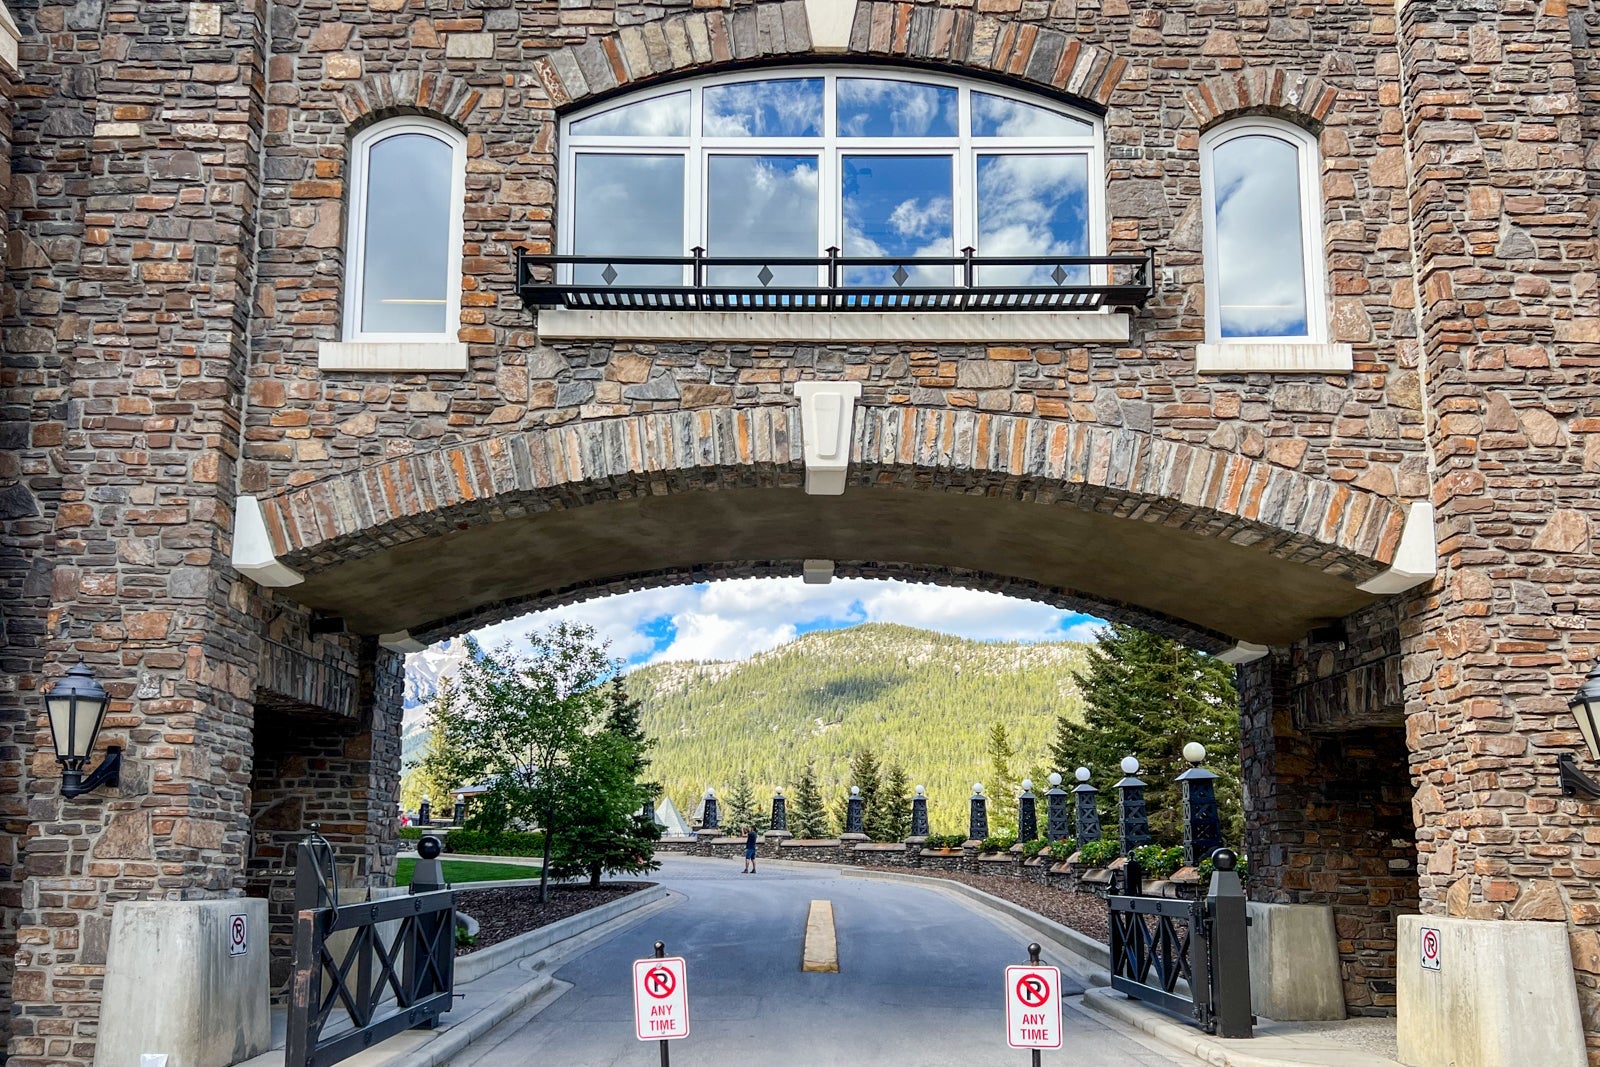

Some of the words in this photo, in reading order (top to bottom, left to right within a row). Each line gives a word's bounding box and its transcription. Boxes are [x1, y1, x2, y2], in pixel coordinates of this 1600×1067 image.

[651, 1004, 673, 1017] ANY
[649, 1019, 676, 1031] TIME
[1022, 1013, 1046, 1025] ANY
[1020, 1028, 1049, 1041] TIME
